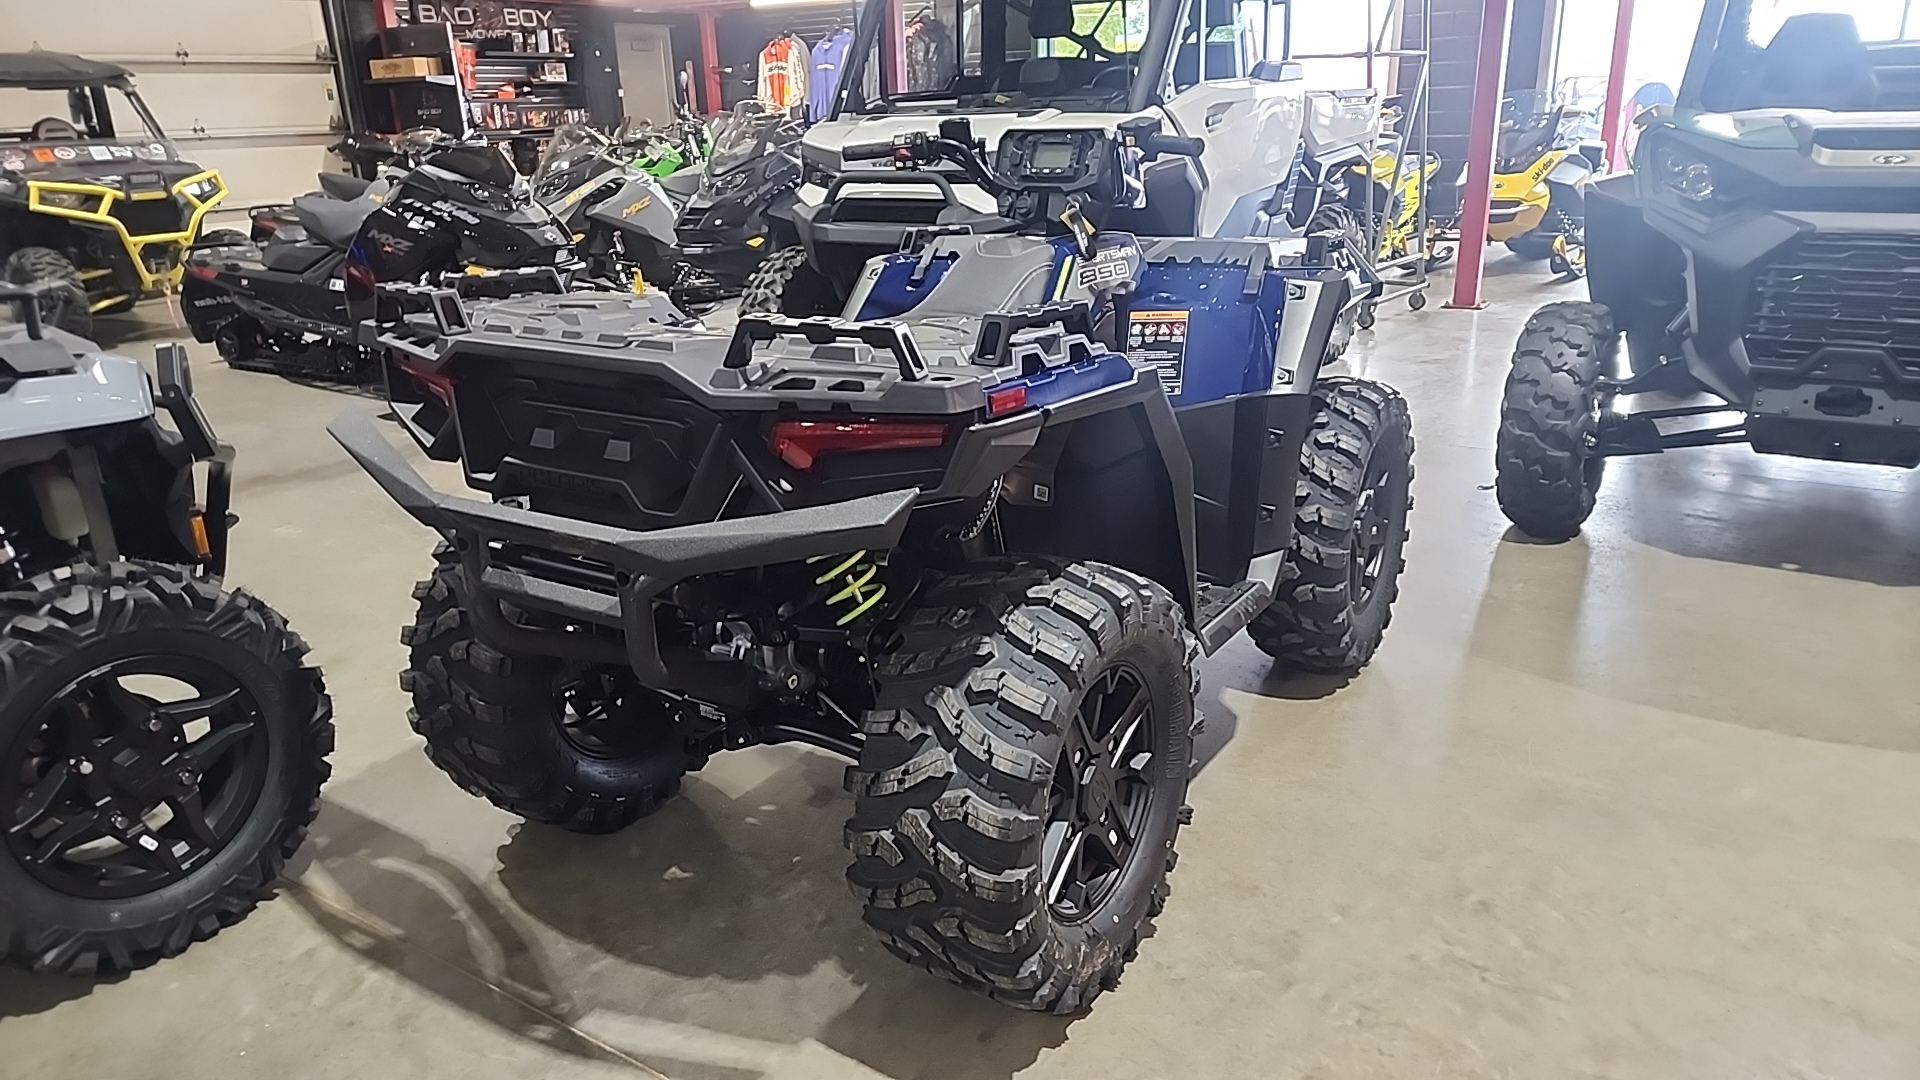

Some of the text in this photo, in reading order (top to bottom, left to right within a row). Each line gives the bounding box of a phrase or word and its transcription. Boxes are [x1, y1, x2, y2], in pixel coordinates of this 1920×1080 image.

[417, 4, 552, 27] BAD BOY
[465, 28, 519, 39] MOWER
[1531, 157, 1554, 182] ski-doo
[1077, 259, 1130, 289] 850
